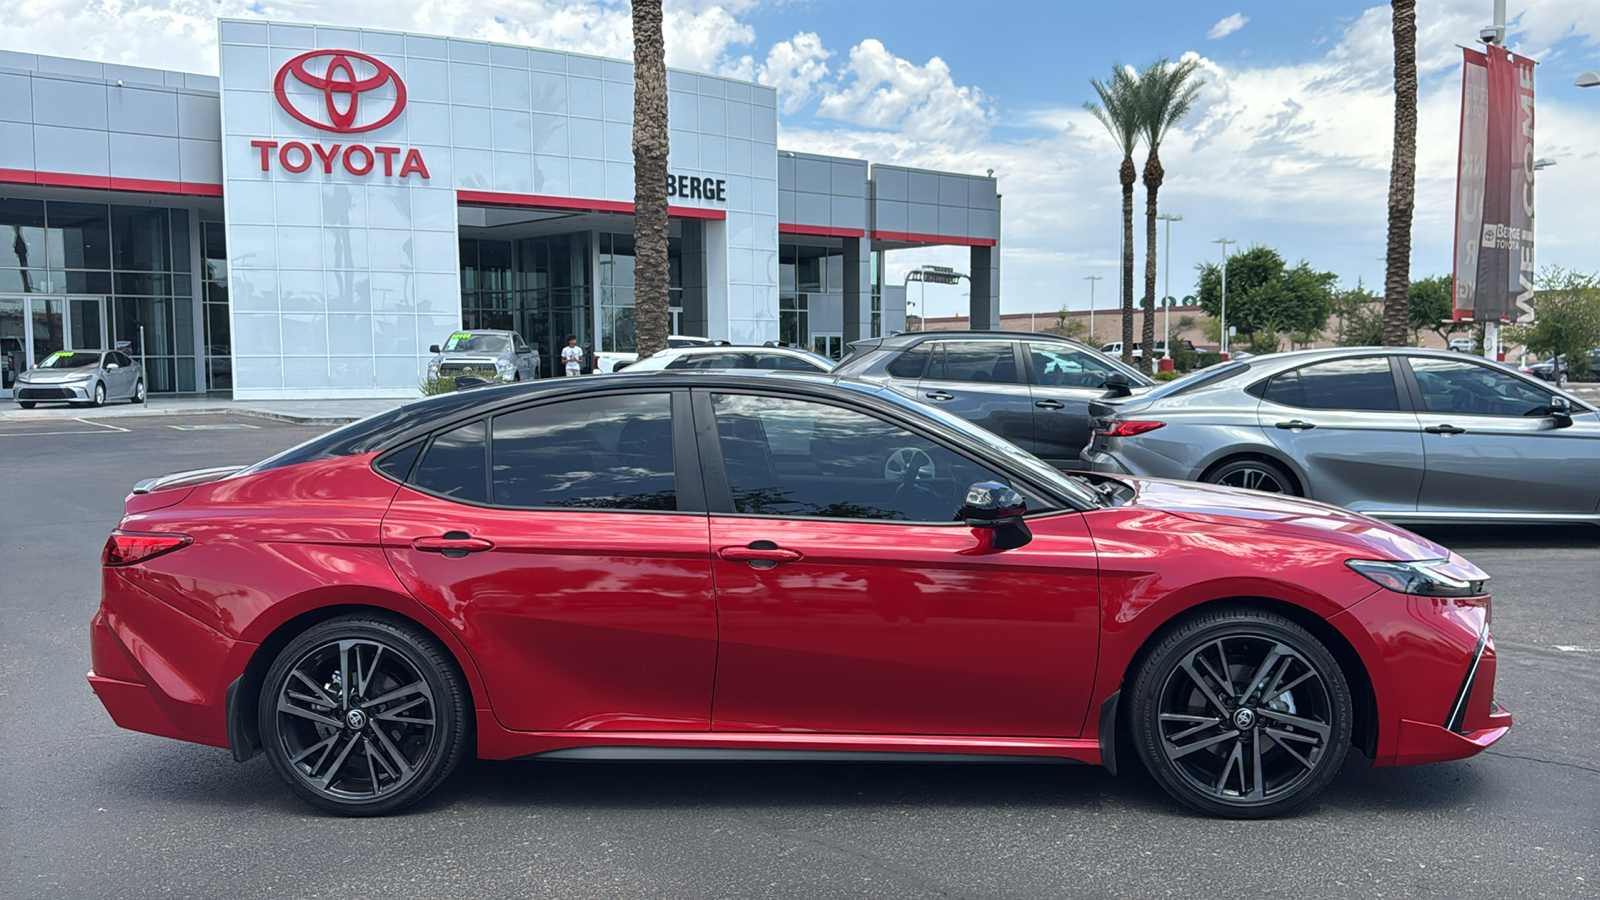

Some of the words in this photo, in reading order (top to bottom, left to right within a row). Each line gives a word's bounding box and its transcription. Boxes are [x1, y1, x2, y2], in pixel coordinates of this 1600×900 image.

[251, 140, 431, 179] TOYOTA
[666, 174, 727, 202] BERGE
[1515, 63, 1535, 323] WELCOME
[1496, 239, 1520, 251] TOYOTA
